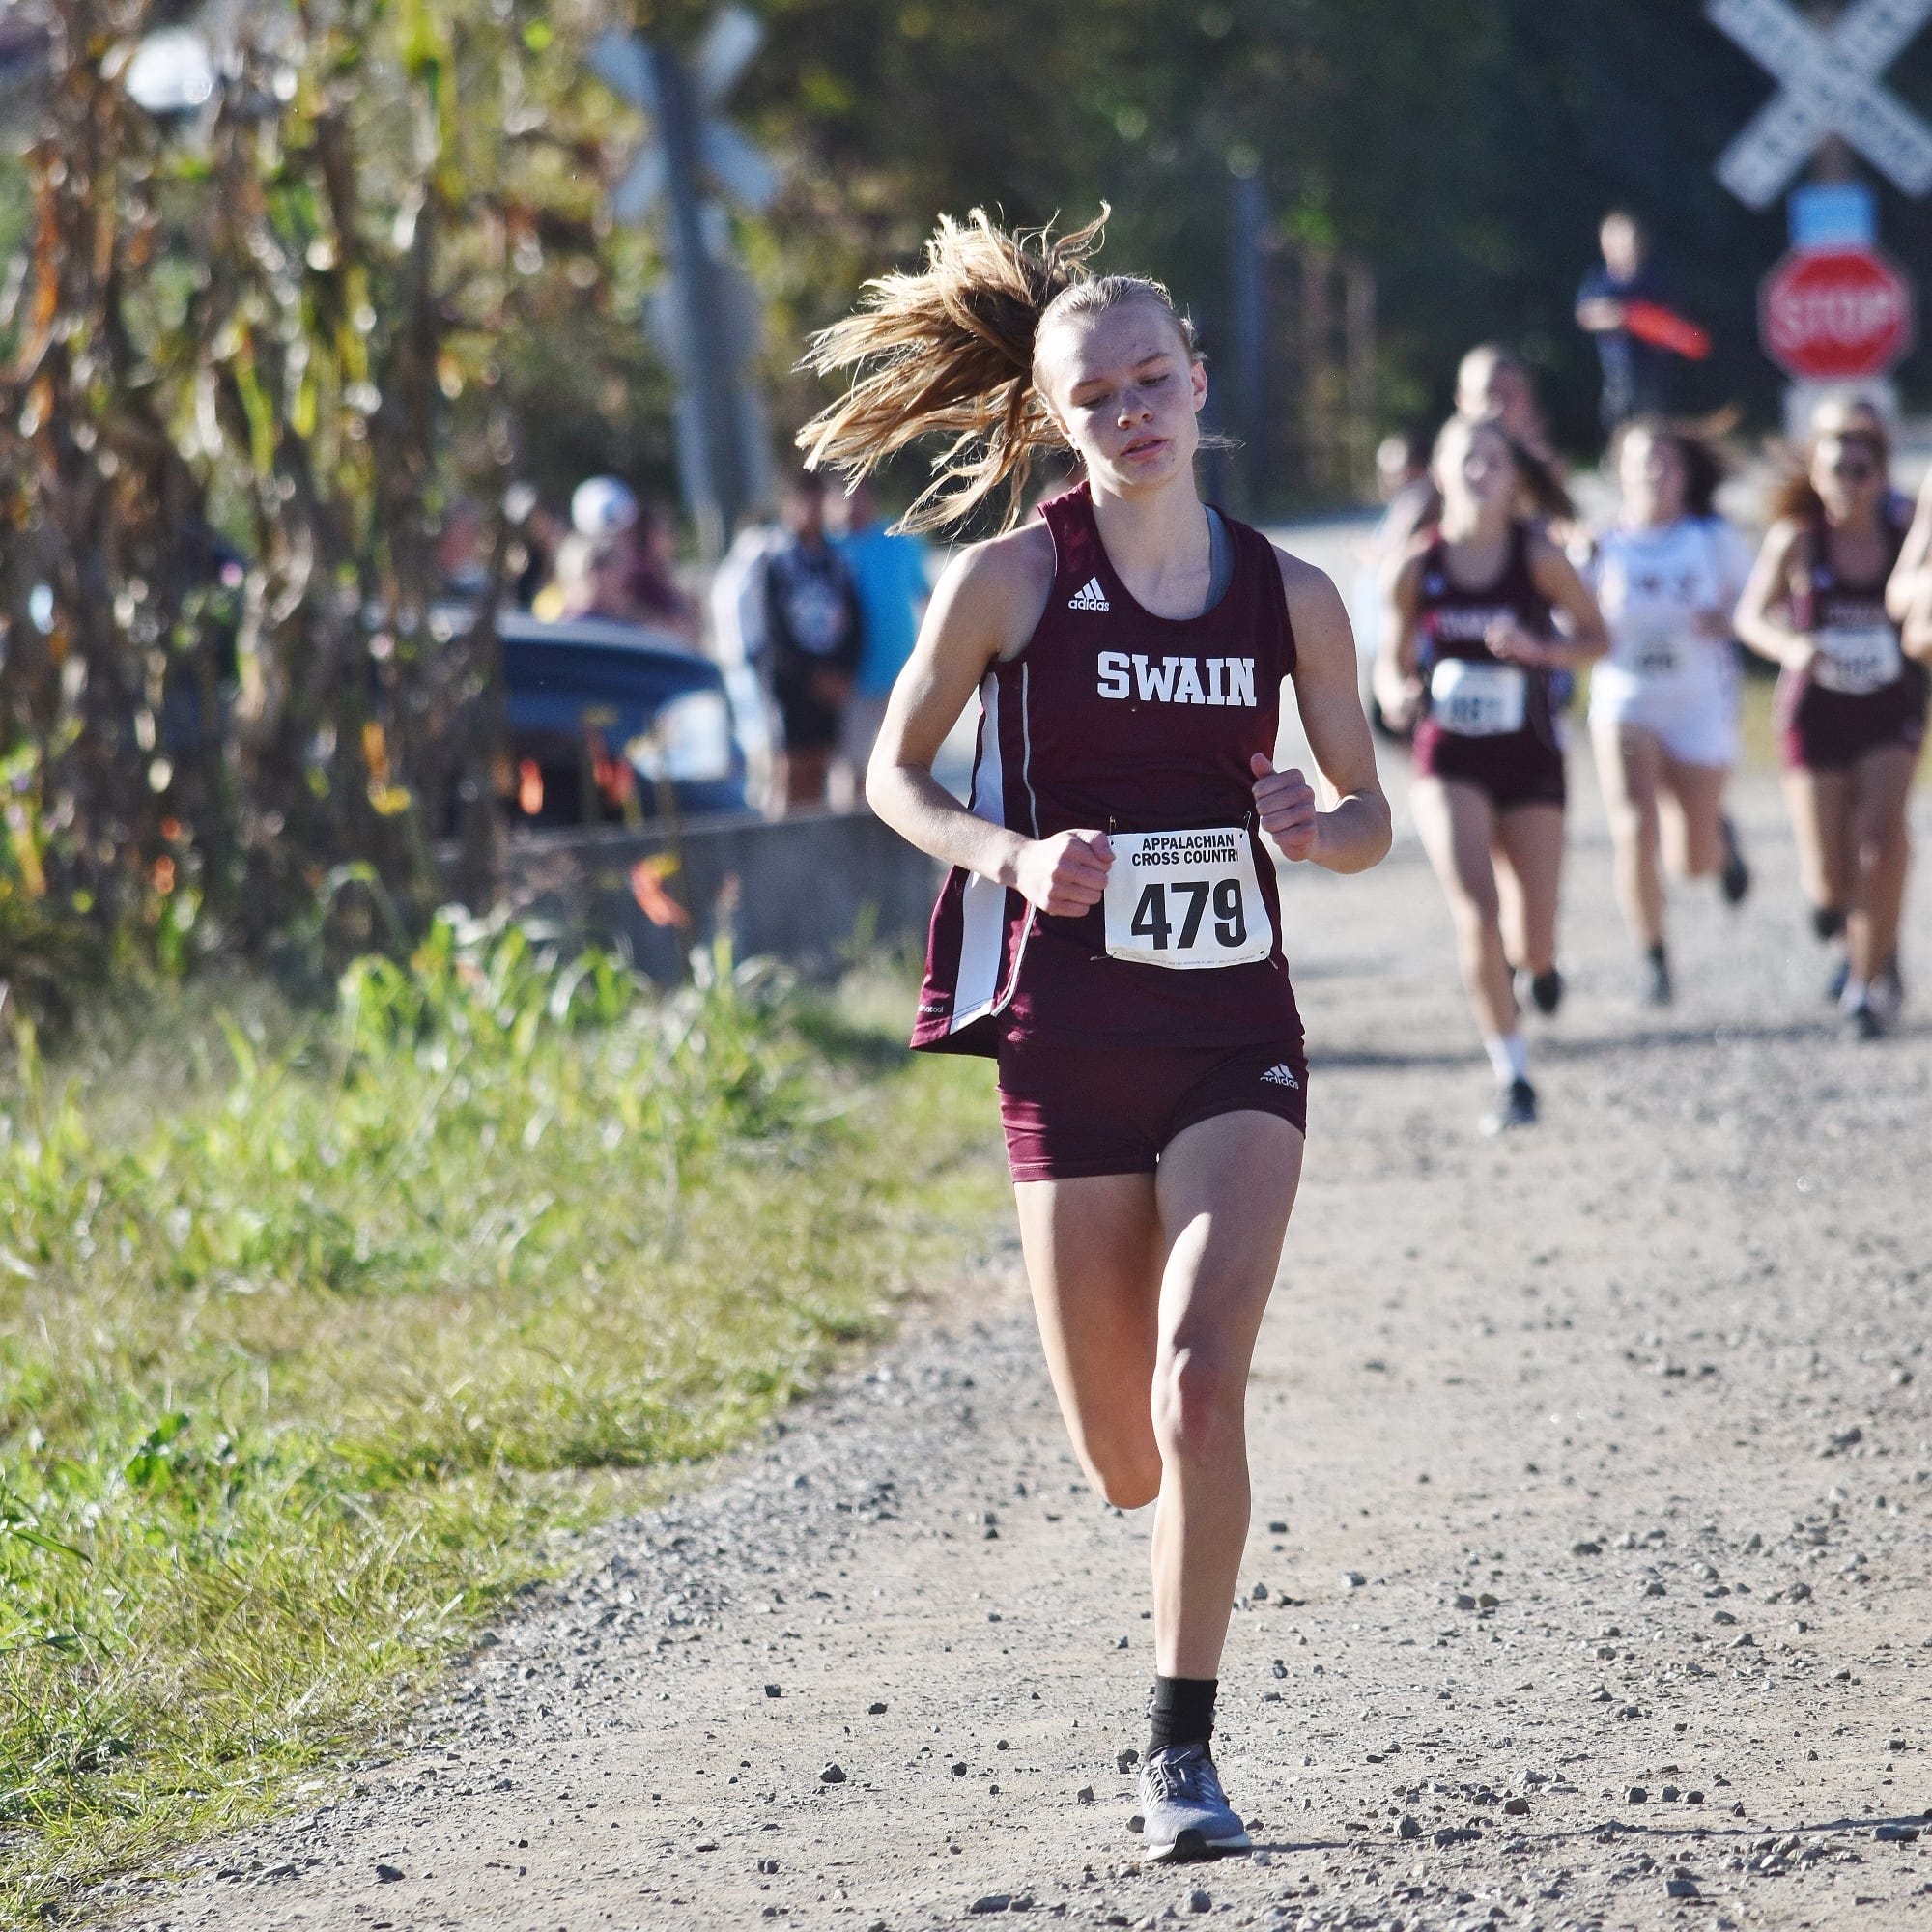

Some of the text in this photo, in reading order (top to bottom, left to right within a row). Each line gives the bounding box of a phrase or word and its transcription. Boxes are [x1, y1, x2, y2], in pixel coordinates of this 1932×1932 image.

[1777, 288, 1896, 348] STOP
[1067, 598, 1110, 612] adidas
[1096, 650, 1258, 707] SWAIN
[1131, 851, 1179, 867] CROSS
[1141, 833, 1235, 852] APPALACHIAN
[1130, 878, 1248, 951] 479
